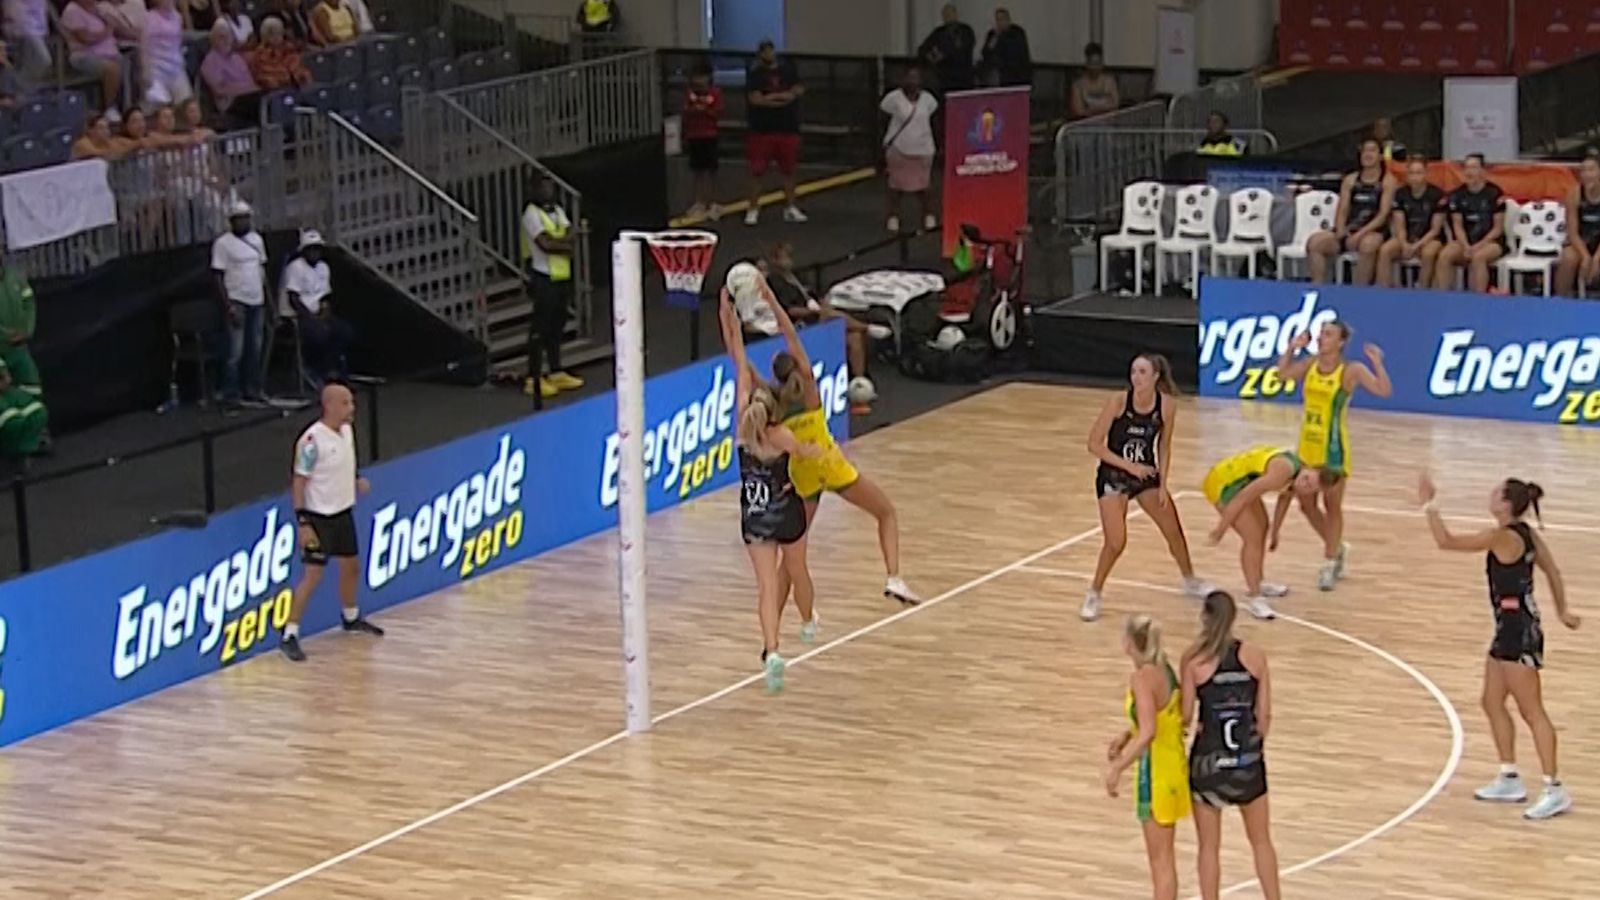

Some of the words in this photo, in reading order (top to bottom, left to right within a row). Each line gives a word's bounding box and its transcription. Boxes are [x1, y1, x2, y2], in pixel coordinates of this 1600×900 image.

[679, 436, 733, 499] zero
[368, 433, 525, 588] Energade
[460, 509, 523, 577] zero
[113, 506, 294, 680] Energade
[220, 588, 292, 662] zero
[1224, 719, 1241, 751] C
